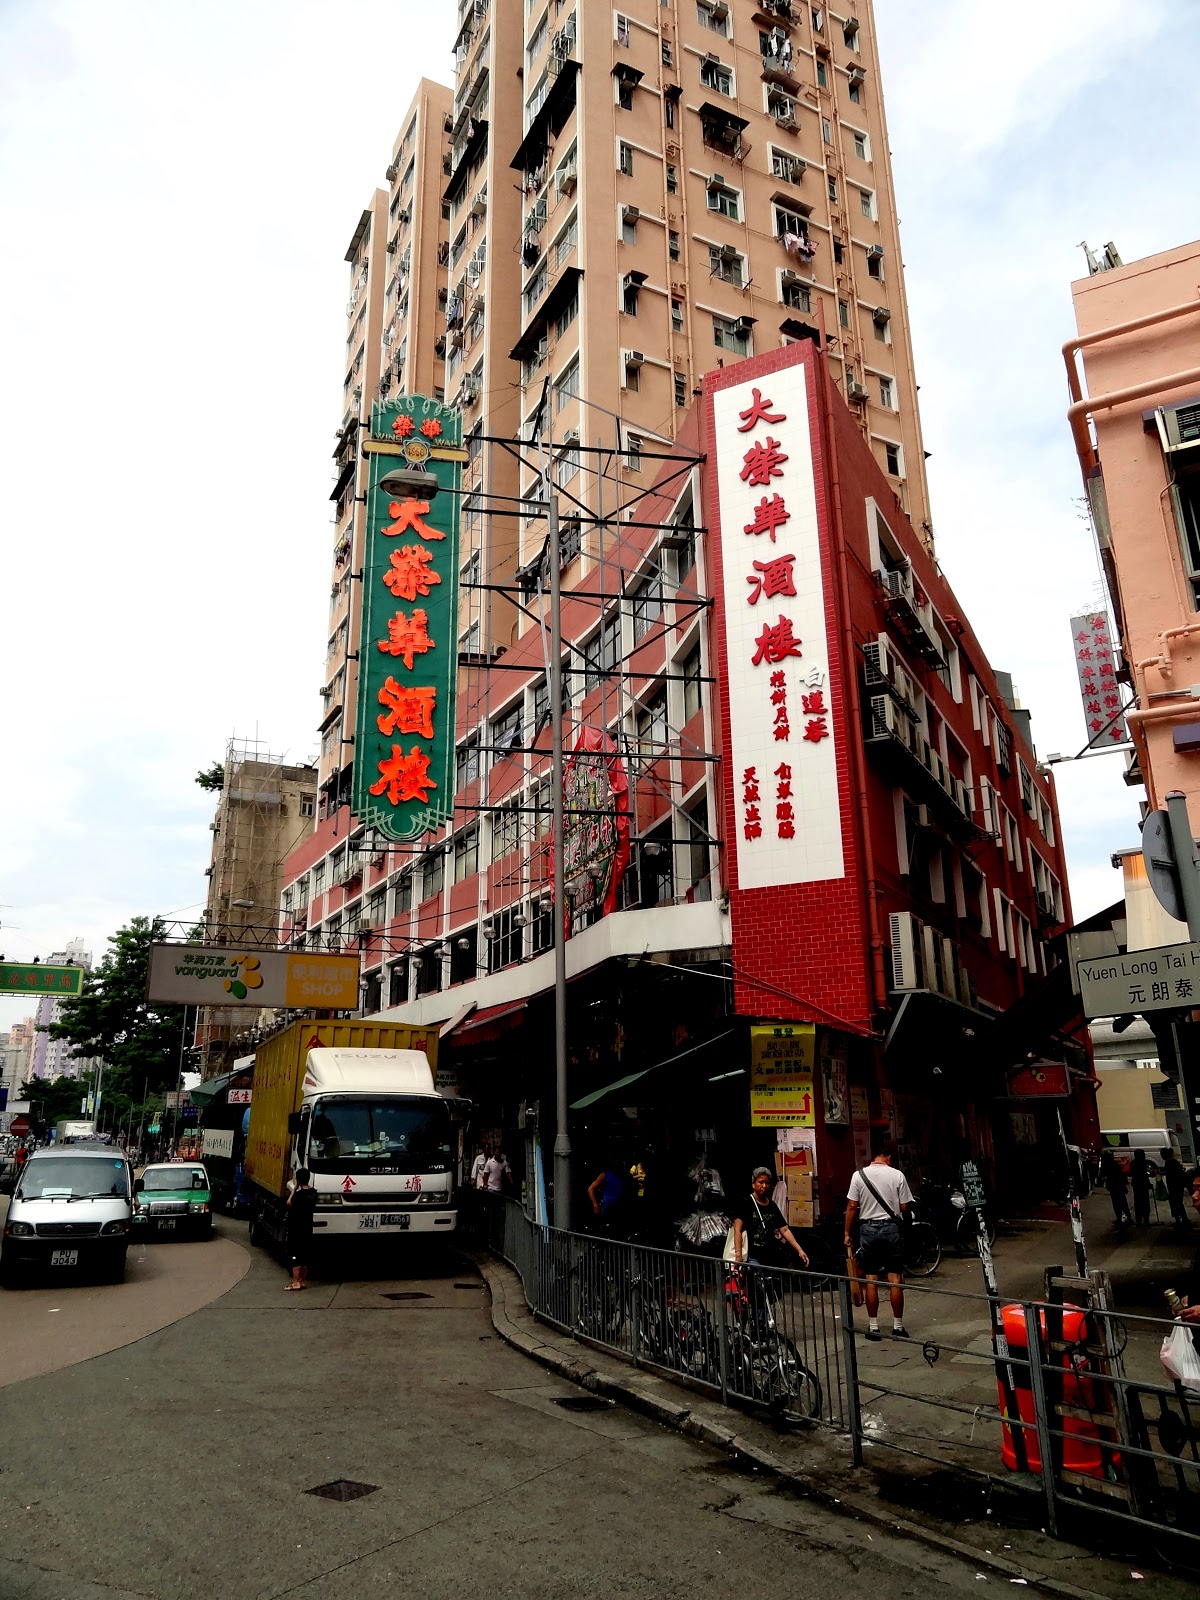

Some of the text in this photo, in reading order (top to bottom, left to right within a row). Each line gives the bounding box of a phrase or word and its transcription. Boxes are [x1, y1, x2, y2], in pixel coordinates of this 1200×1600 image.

[392, 414, 443, 440] 榮華
[374, 431, 458, 447] WING WAH
[737, 387, 803, 666] 大榮華酒樓
[369, 498, 447, 806] 大榮華酒樓
[800, 665, 830, 743] 白蓮蓉
[183, 953, 227, 967] 华润万家
[1082, 967, 1118, 982] Yuen
[1121, 961, 1158, 976] Long
[1162, 953, 1187, 969] Tai
[174, 965, 239, 979] vanguard
[302, 981, 344, 996] SHOP
[1128, 978, 1193, 1004] 元朗泰
[341, 1175, 357, 1193] 金
[59, 1250, 71, 1258] PU
